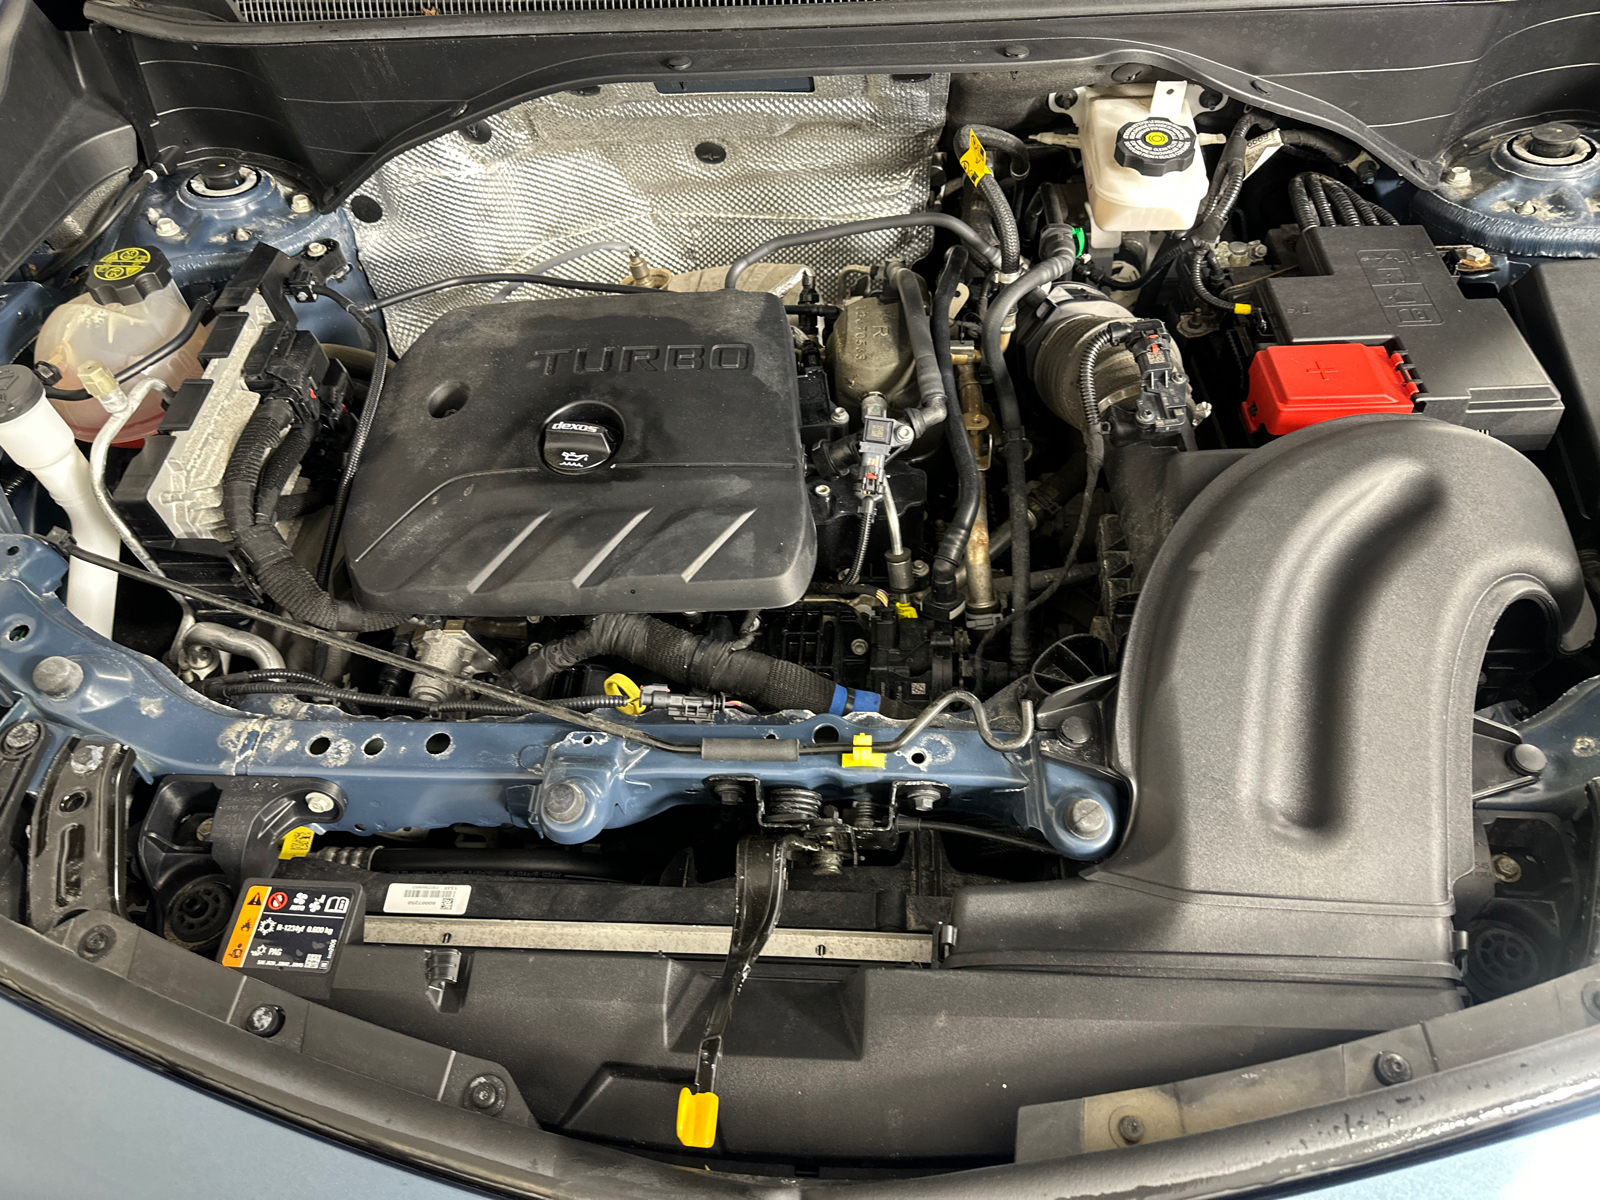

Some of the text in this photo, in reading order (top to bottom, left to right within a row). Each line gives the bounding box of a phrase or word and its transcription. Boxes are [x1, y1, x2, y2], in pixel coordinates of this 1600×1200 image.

[872, 325, 889, 338] R
[534, 343, 752, 376] TURBO
[551, 421, 600, 433] dexos
[276, 923, 305, 934] R-1234yf
[324, 926, 334, 936] kg
[267, 947, 283, 957] PAG
